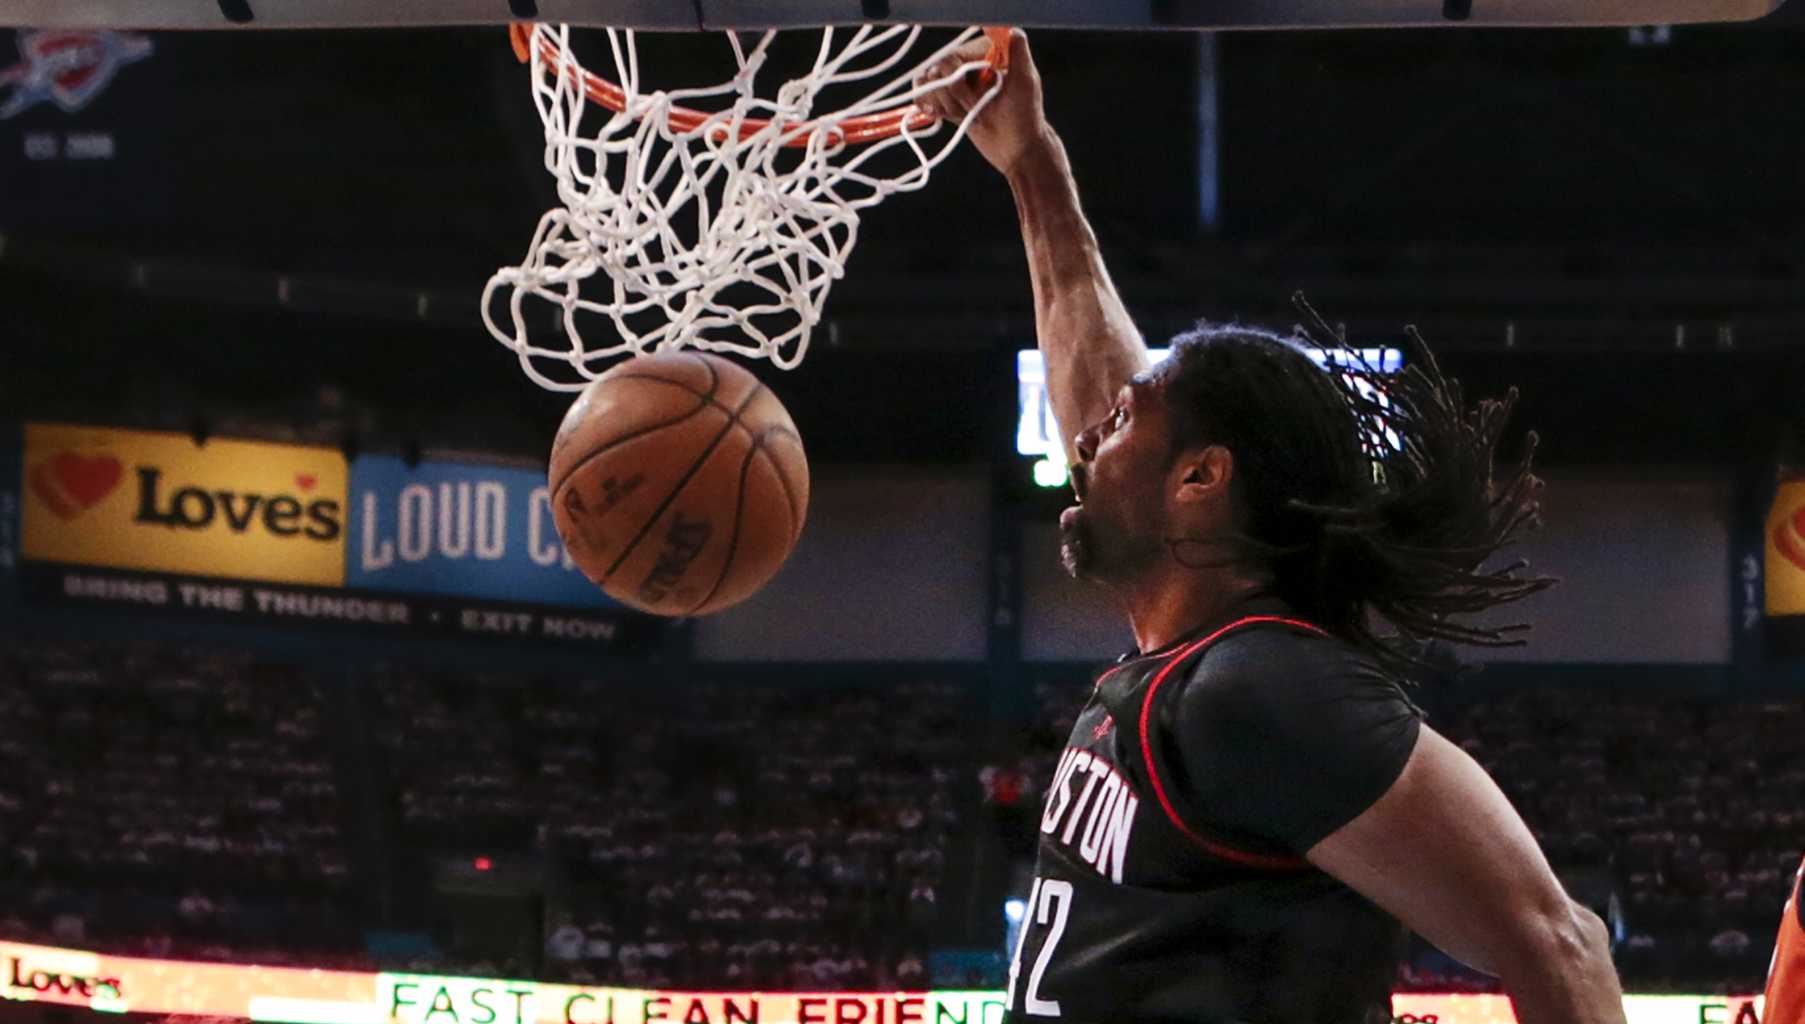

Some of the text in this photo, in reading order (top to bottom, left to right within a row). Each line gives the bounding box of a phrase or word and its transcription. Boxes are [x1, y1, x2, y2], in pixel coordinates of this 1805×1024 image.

[360, 481, 505, 571] LOUD
[178, 584, 245, 612] THE
[257, 591, 411, 624] THUNDER
[459, 608, 532, 633] EXIT
[542, 617, 617, 641] NOW
